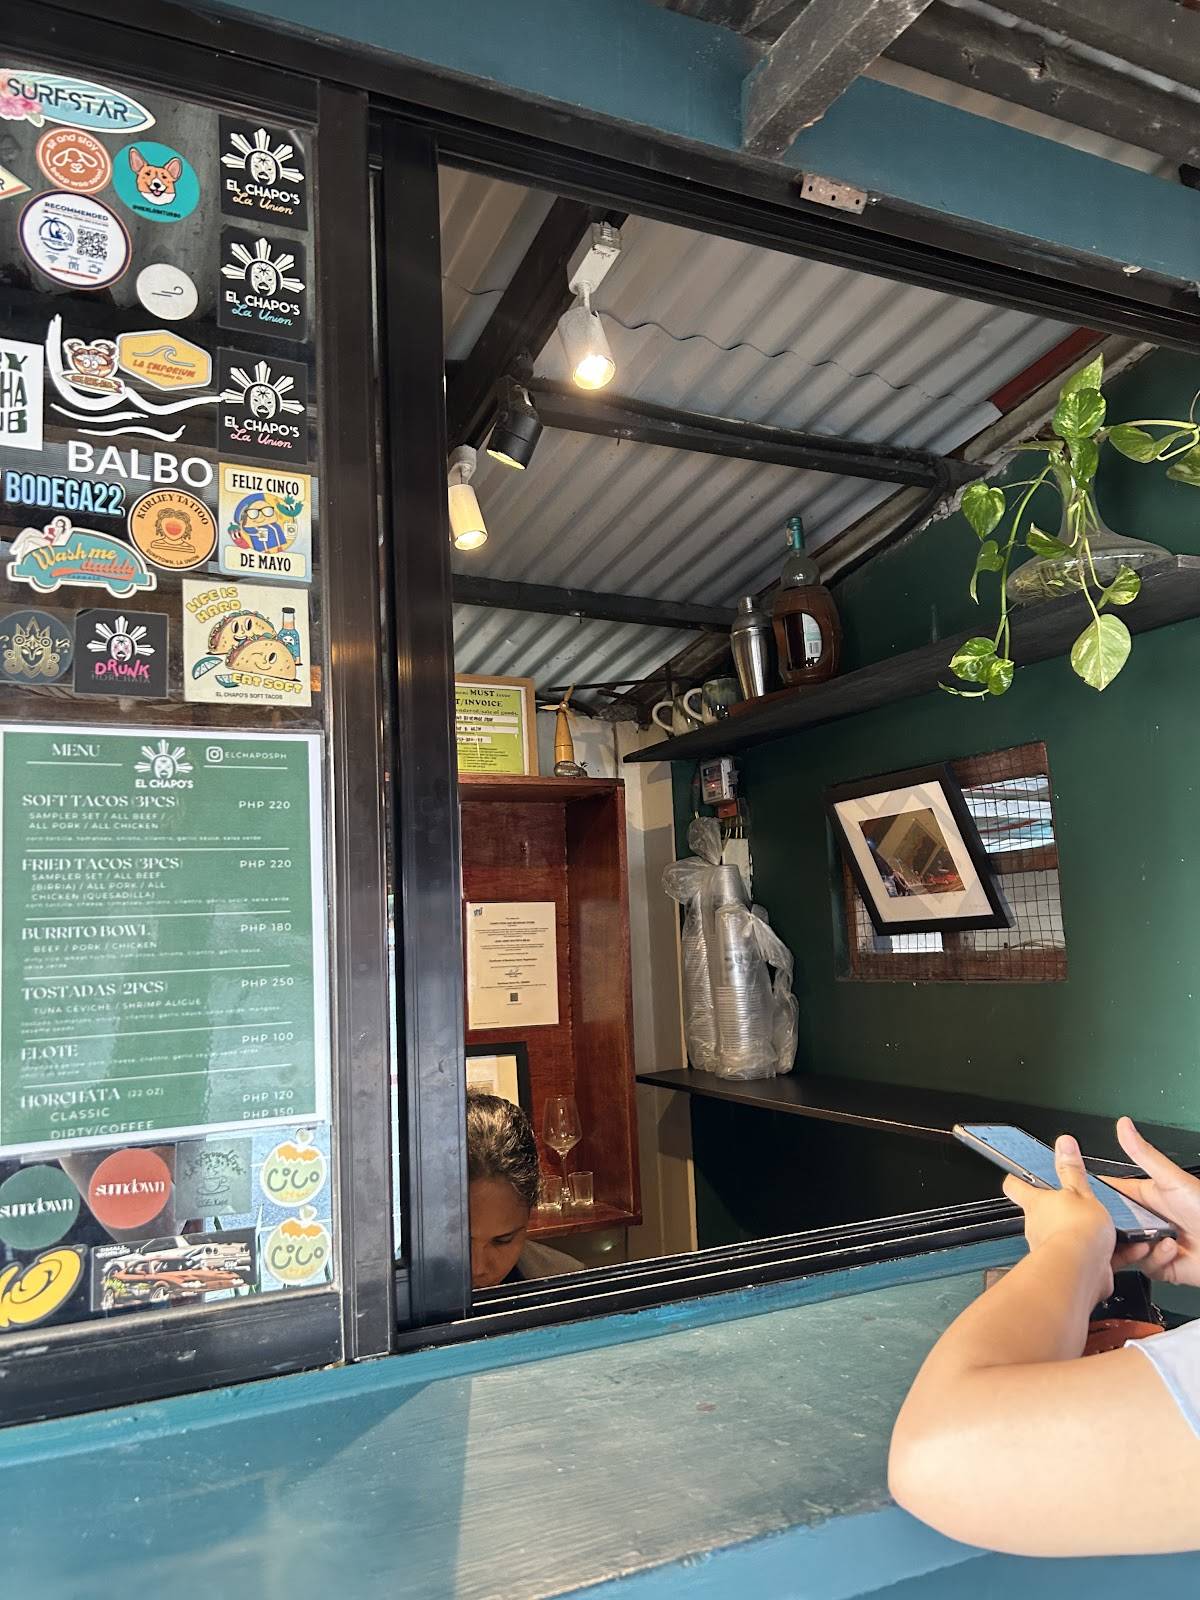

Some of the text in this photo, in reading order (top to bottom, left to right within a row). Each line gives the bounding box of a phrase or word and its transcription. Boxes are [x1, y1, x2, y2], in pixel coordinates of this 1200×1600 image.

[7, 78, 128, 122] SURFSTAR
[226, 179, 301, 205] EL CHAPO'S
[44, 201, 109, 221] RECOMMENDED
[233, 192, 294, 215] La Union
[225, 290, 301, 316] EL CHAPO'S
[232, 302, 294, 326] La Union
[224, 415, 300, 438] EL CHAPO'S
[231, 428, 293, 449] La Union
[68, 439, 214, 488] BALBO
[5, 470, 123, 516] BODEGA22
[232, 473, 300, 496] FELIZ CINCO
[177, 494, 210, 526] TATTOO
[31, 543, 87, 571] Wash
[88, 547, 118, 561] me
[240, 552, 292, 572] DE MAYO
[185, 587, 239, 613] LIFE IS
[195, 600, 242, 624] HARD
[95, 658, 150, 679] DRUNK
[231, 672, 304, 694] EAT SOFT
[470, 689, 495, 699] MUST
[52, 743, 101, 757] MENU
[225, 751, 288, 760] ELCHAPOSPH
[135, 778, 194, 789] EL CHAPO'S
[22, 794, 180, 808] SOFT TACOS (3PCS)
[239, 800, 291, 809] PHP 220
[28, 812, 79, 821] SAMPLER
[81, 812, 99, 821] SET
[110, 812, 131, 821] ALL
[132, 812, 158, 821] BEEF
[28, 822, 48, 830] ALL
[52, 822, 81, 830] PORK
[91, 822, 111, 830] ALL
[113, 822, 160, 830] CHICKEN
[22, 857, 184, 871] FRIED TACOS (3PCS)
[239, 859, 292, 868] PHP 220
[31, 872, 81, 881] SAMPLER
[84, 872, 102, 881] SET
[113, 872, 133, 880] ALL
[135, 871, 162, 880] BEEF
[86, 881, 106, 890] ALL
[108, 881, 138, 890] PORK
[148, 880, 168, 889] ALL
[31, 893, 79, 901] CHICKEN
[22, 923, 152, 941] BURRITO BOWL
[240, 922, 292, 932] PHP 180
[33, 944, 60, 953] BEEF
[72, 943, 101, 952] PORK
[112, 941, 158, 951] CHICKEN
[241, 977, 295, 988] PHP 250
[21, 983, 117, 1001] TOSTADAS
[33, 1005, 63, 1015] TUNA
[65, 1002, 112, 1014] CEVICHE
[122, 1000, 162, 1010] SHRIMP
[242, 1031, 294, 1044] PHP 100
[21, 1044, 80, 1061] ELOTE
[21, 1087, 121, 1109] HORCHATA
[242, 1089, 294, 1103] PHP 120
[50, 1107, 111, 1122] CLASSIC
[243, 1106, 294, 1120] PHP 150
[50, 1120, 155, 1141] DIRTY/COFFEE
[96, 1178, 165, 1197] sundown
[0, 1197, 74, 1218] sundown
